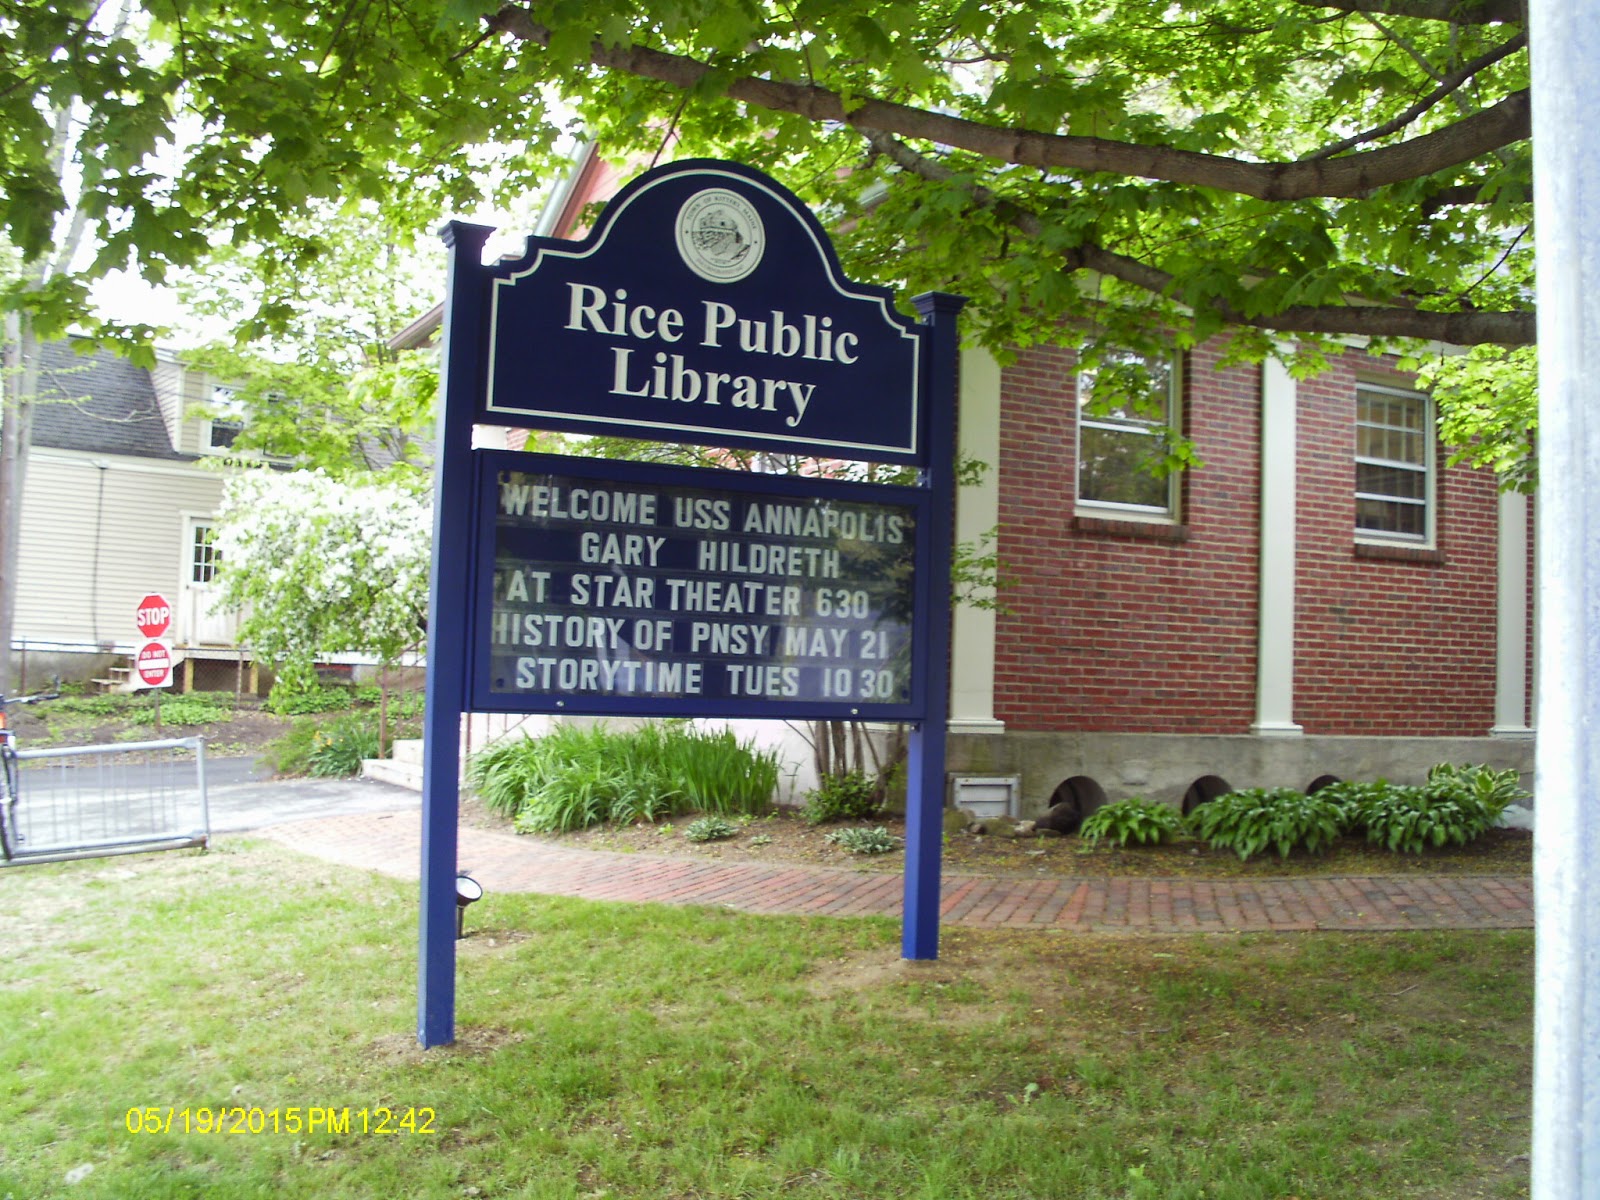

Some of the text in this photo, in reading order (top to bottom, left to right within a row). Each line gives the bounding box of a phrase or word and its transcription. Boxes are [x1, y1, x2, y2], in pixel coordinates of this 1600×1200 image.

[563, 282, 860, 365] Rice Public
[608, 347, 816, 427] Library
[503, 483, 904, 544] WELCOME USS ANNAPOLIS
[581, 532, 840, 579] GARY HILDRETH
[138, 607, 169, 627] STOP
[506, 570, 870, 620] AT STAR THEATER 630
[492, 613, 889, 660] HISTORY OF PNSY MAY 21
[143, 669, 165, 678] ENTER
[516, 657, 702, 694] STORYTIME
[726, 665, 799, 697] TUES
